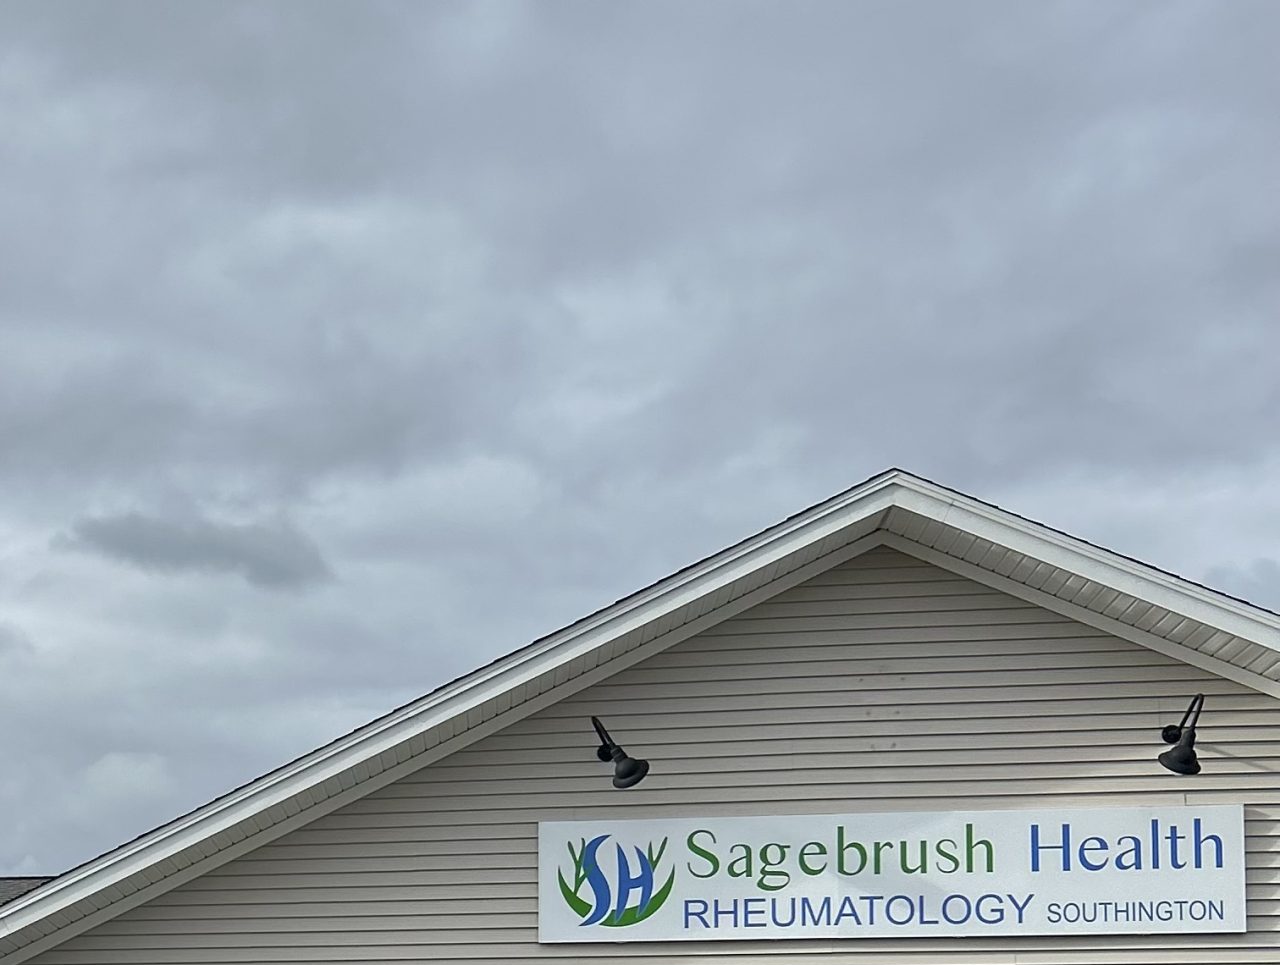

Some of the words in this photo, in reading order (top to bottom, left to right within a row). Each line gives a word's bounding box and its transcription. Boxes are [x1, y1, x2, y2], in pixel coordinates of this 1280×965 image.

[685, 822, 996, 891] Sagebrush
[1030, 818, 1224, 872] Health
[682, 893, 1035, 929] RHEUMATOLOGY
[1046, 900, 1225, 923] SOUTHINGTON
